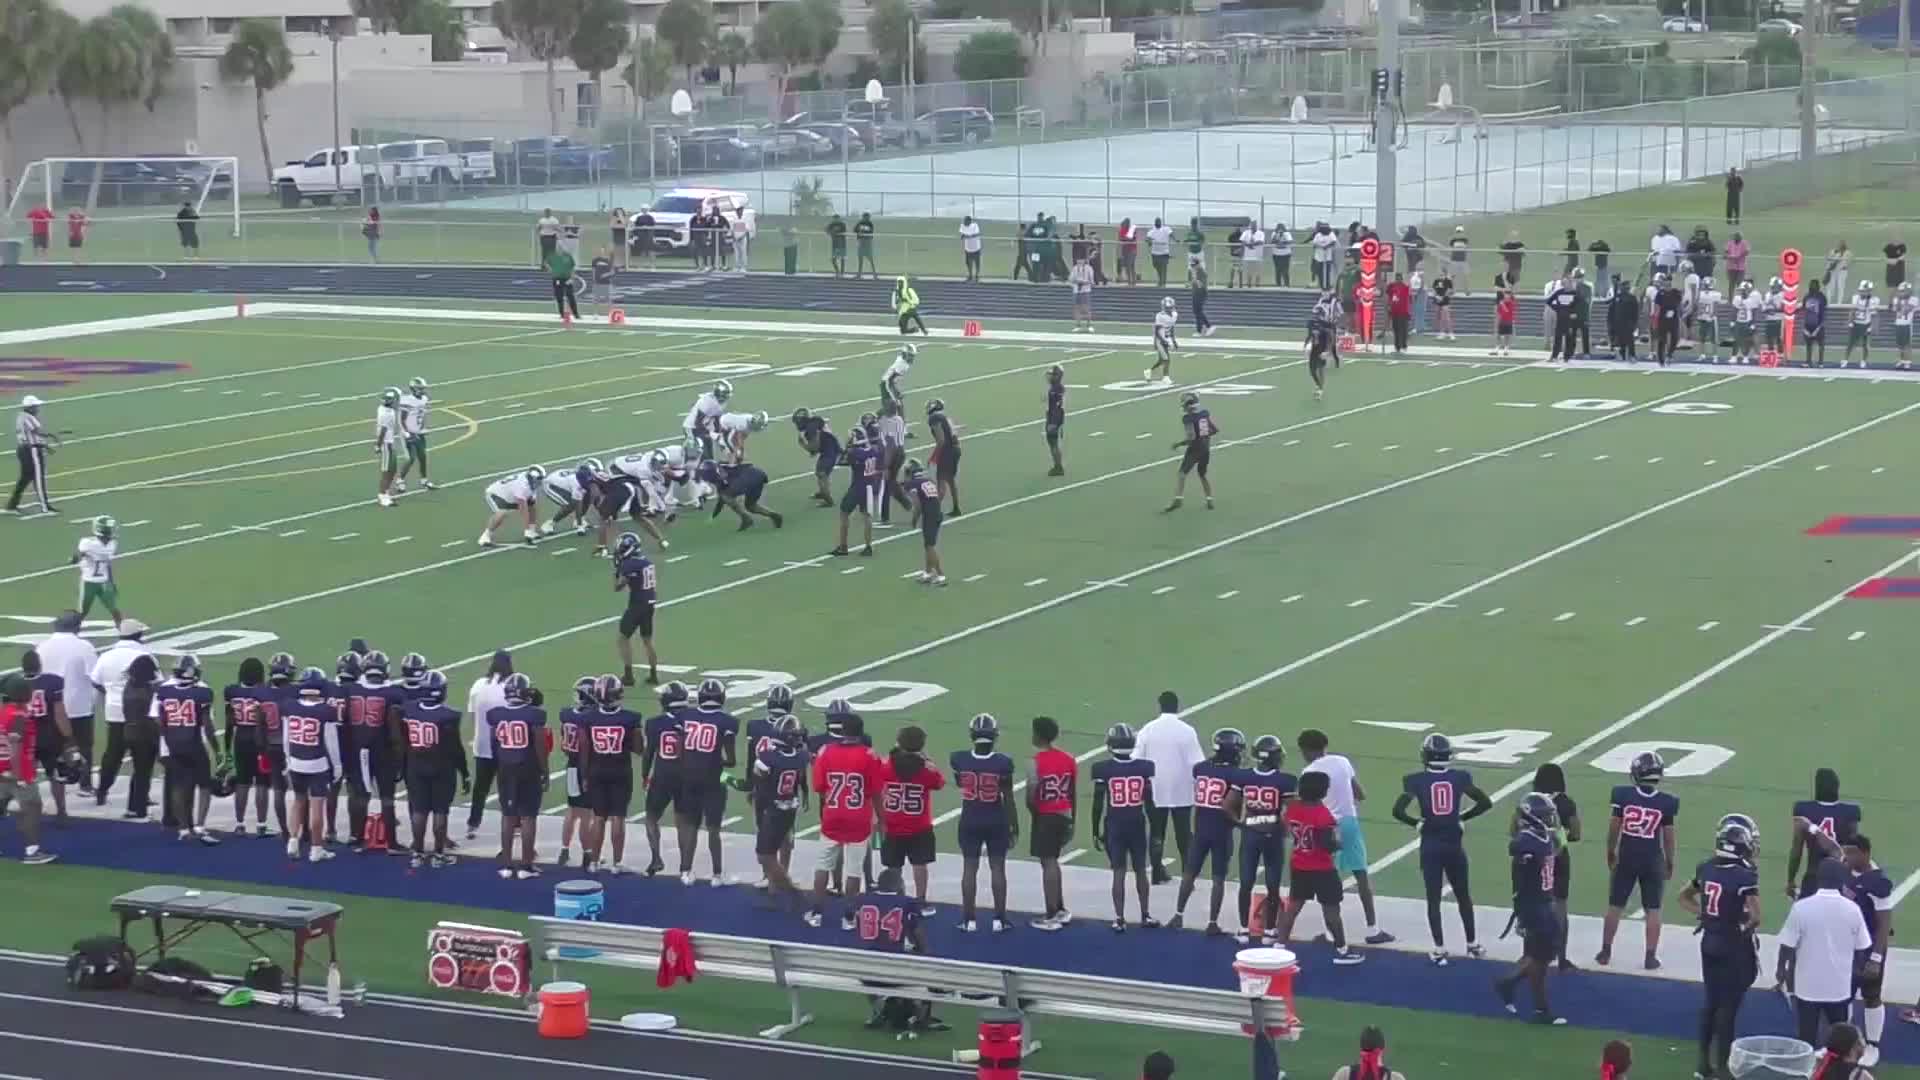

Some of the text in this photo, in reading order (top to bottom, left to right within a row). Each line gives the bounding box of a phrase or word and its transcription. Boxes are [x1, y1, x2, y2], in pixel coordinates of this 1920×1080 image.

[163, 698, 197, 727] 24
[495, 719, 530, 749] 40
[590, 725, 626, 755] 57
[684, 720, 718, 753] 70
[826, 771, 865, 810] 73
[881, 782, 925, 815] 55
[1109, 776, 1146, 808] 88
[1431, 781, 1454, 815] 0
[1623, 804, 1663, 839] 27
[1704, 880, 1722, 917] 7
[859, 904, 904, 942] 84
